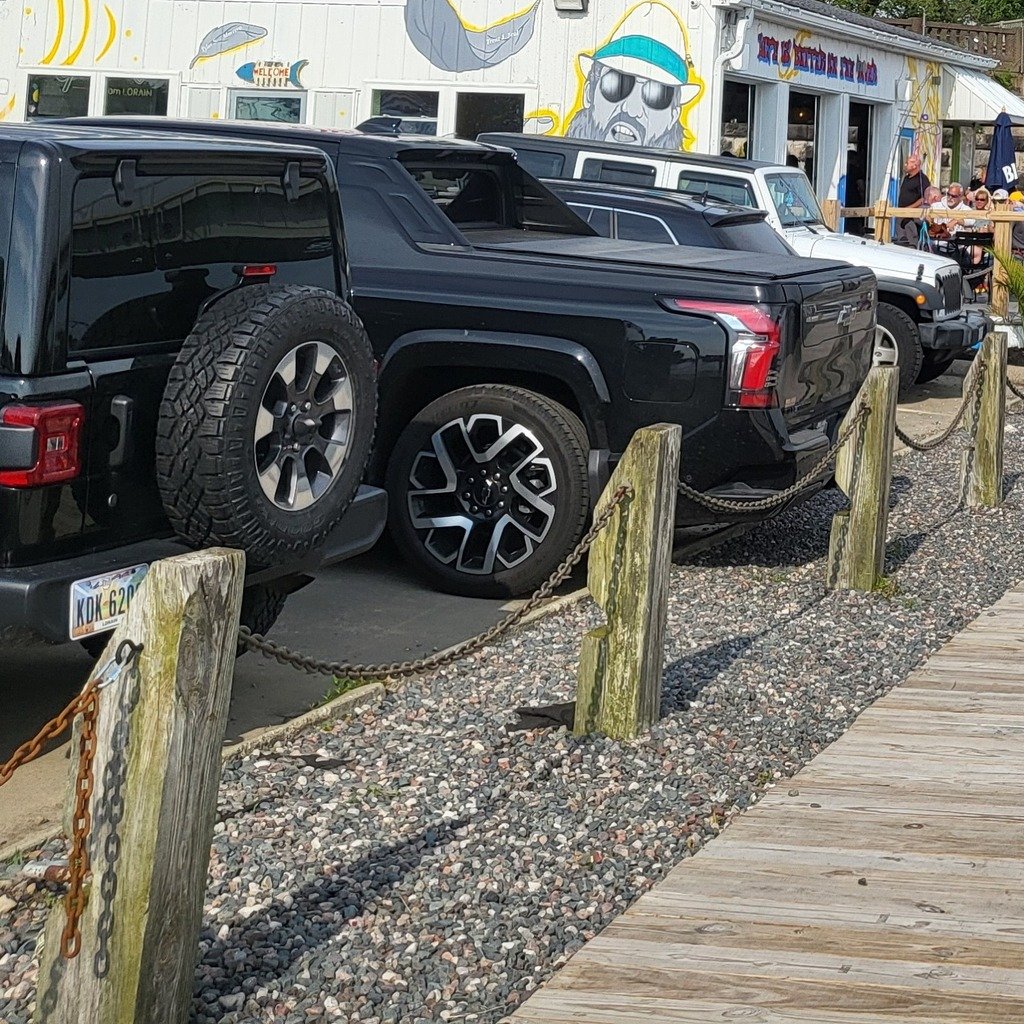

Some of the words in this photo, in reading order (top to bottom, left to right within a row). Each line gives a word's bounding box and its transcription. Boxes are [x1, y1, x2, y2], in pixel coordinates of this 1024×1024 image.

[253, 67, 290, 78] WELCOME
[122, 87, 153, 97] LORAIN
[77, 592, 103, 628] KDK
[109, 582, 141, 617] 620
